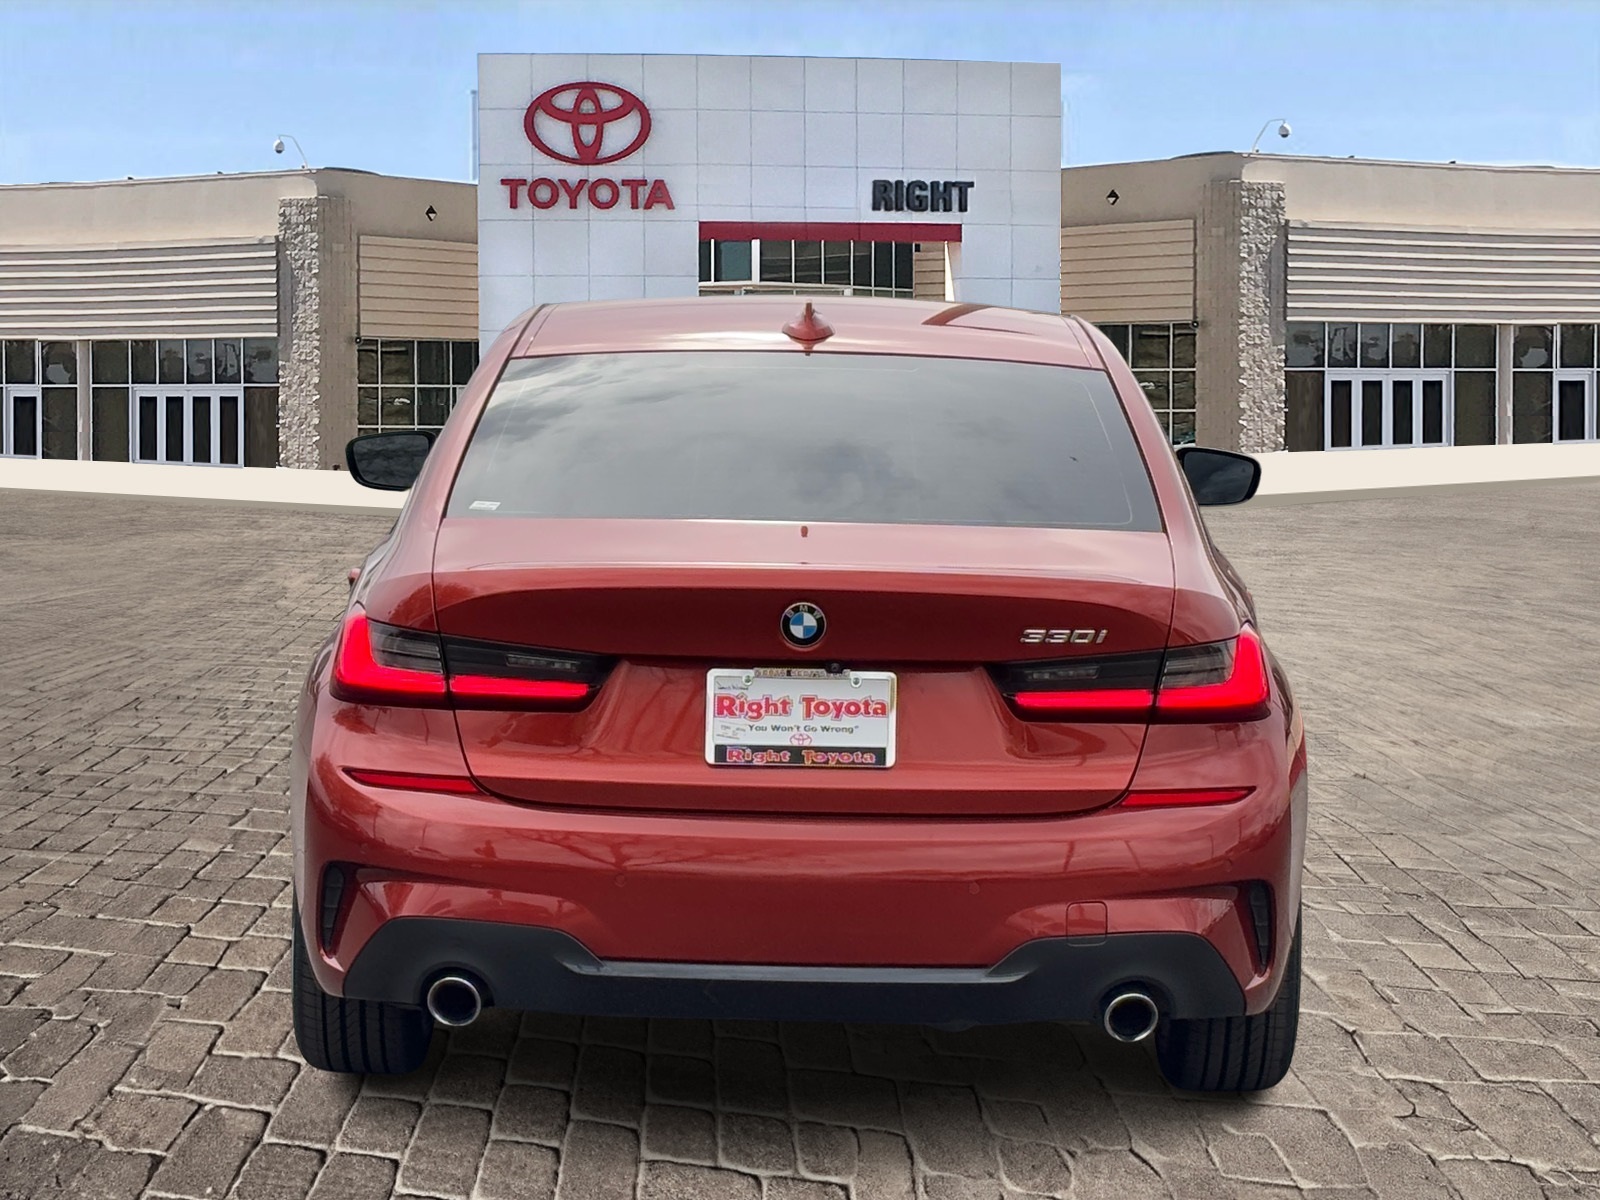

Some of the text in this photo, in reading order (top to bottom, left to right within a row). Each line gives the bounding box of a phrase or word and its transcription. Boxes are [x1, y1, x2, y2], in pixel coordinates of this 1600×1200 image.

[501, 178, 675, 210] TOYOTA
[872, 180, 974, 212] RIGHT
[785, 604, 823, 619] BMW
[1020, 628, 1108, 644] 330i
[714, 693, 888, 721] Right Toyota
[804, 724, 818, 732] Go
[726, 746, 876, 765] Right Toyota
